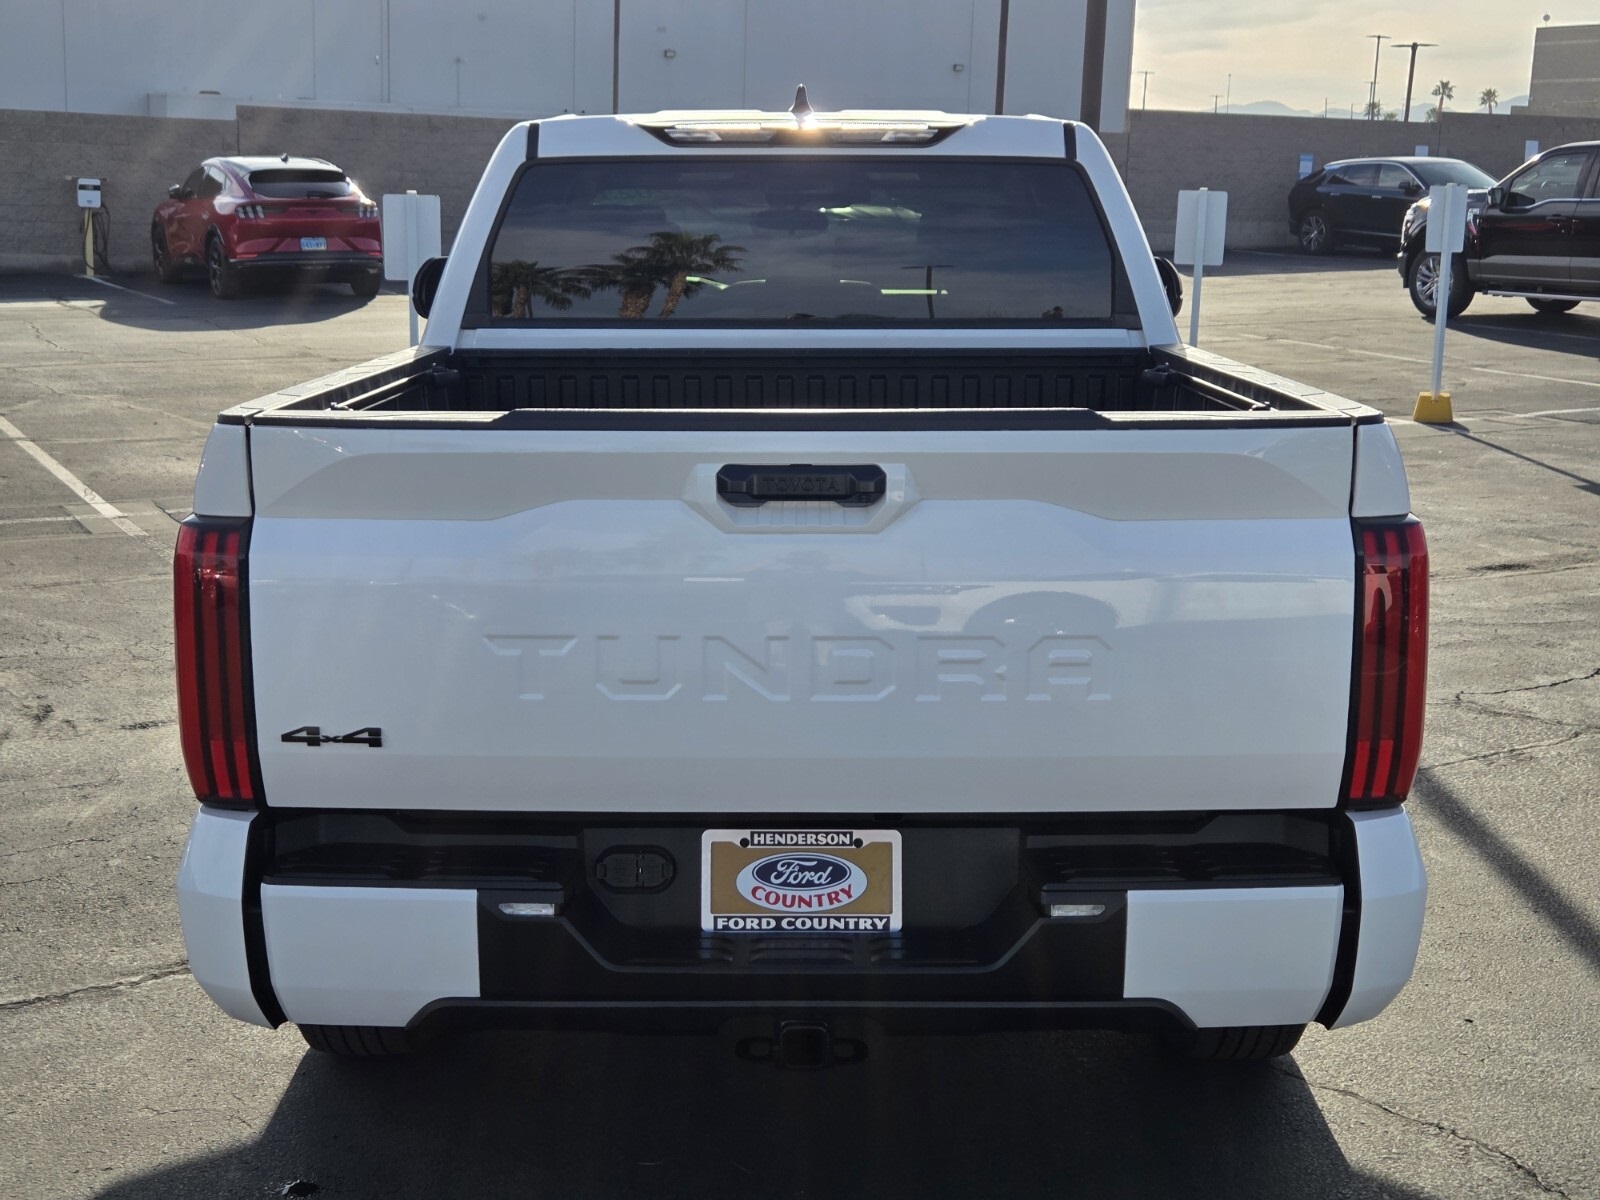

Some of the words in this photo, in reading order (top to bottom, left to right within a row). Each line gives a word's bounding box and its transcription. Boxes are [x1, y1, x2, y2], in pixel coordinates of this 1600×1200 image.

[763, 476, 839, 492] TOYOTA
[482, 634, 1113, 703] TUNDRA
[753, 833, 851, 845] HENDERSON
[770, 859, 834, 884] Ford
[751, 884, 854, 908] COUNTRY
[717, 917, 777, 930] FORD
[781, 917, 888, 930] COUNTRY
